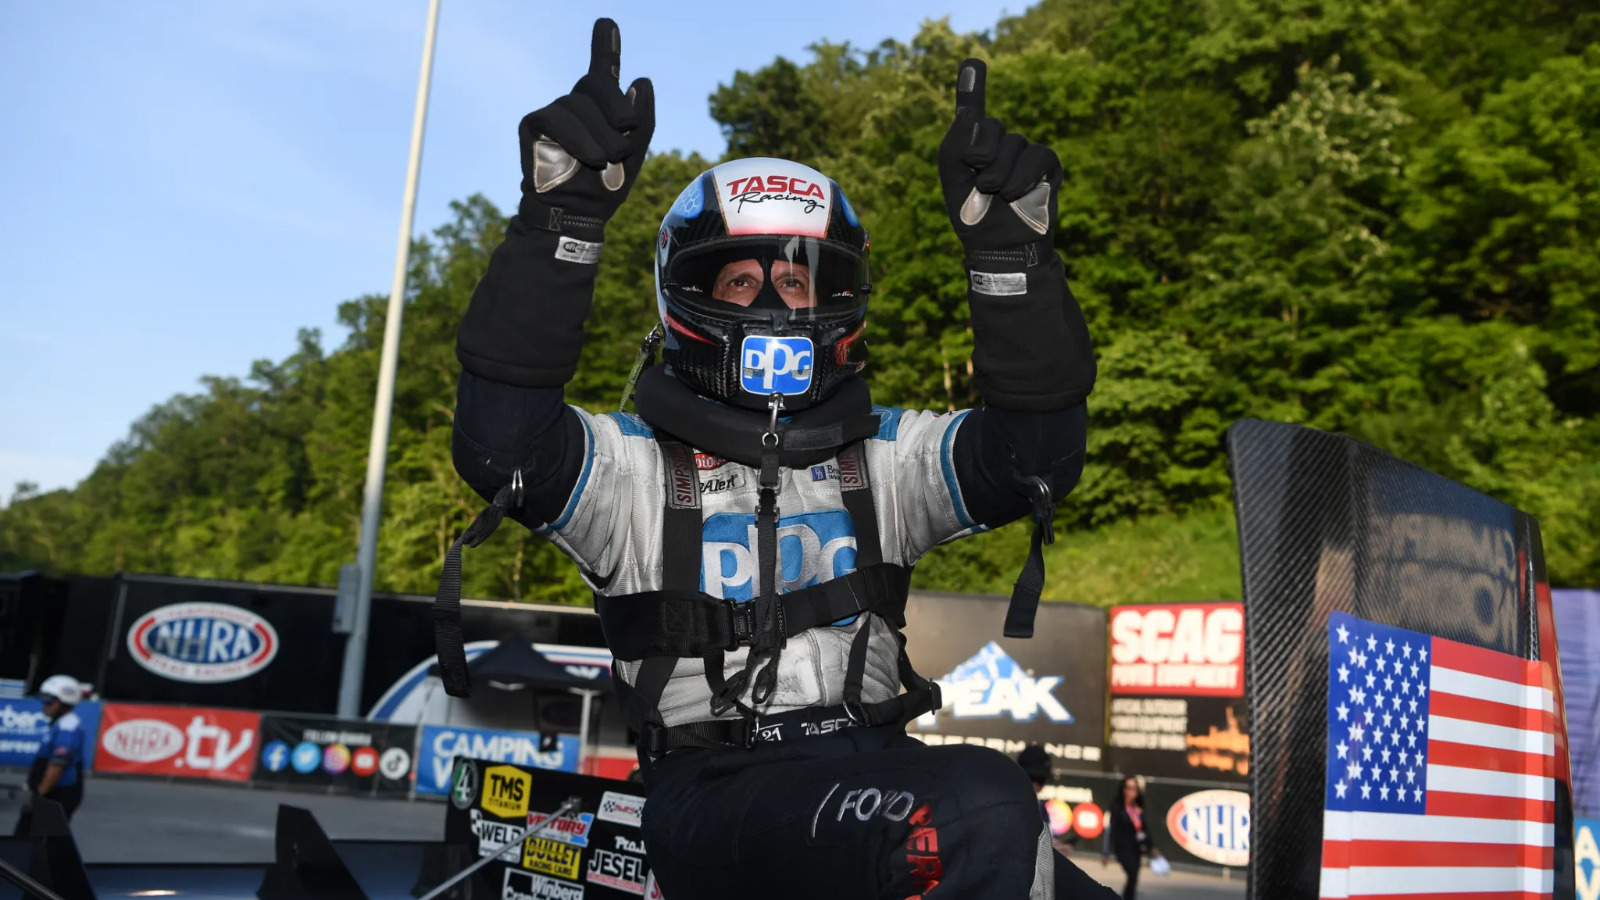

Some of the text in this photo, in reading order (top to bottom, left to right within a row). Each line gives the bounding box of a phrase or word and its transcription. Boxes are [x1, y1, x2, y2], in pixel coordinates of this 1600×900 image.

[726, 175, 825, 200] TASCA
[729, 191, 825, 213] Racing
[155, 619, 253, 663] NHRA
[1112, 608, 1242, 663] SCAG
[115, 725, 172, 750] NHRA
[761, 727, 782, 741] 21
[491, 773, 524, 802] TMS
[527, 838, 579, 867] BULLET
[590, 852, 646, 885] JESEL
